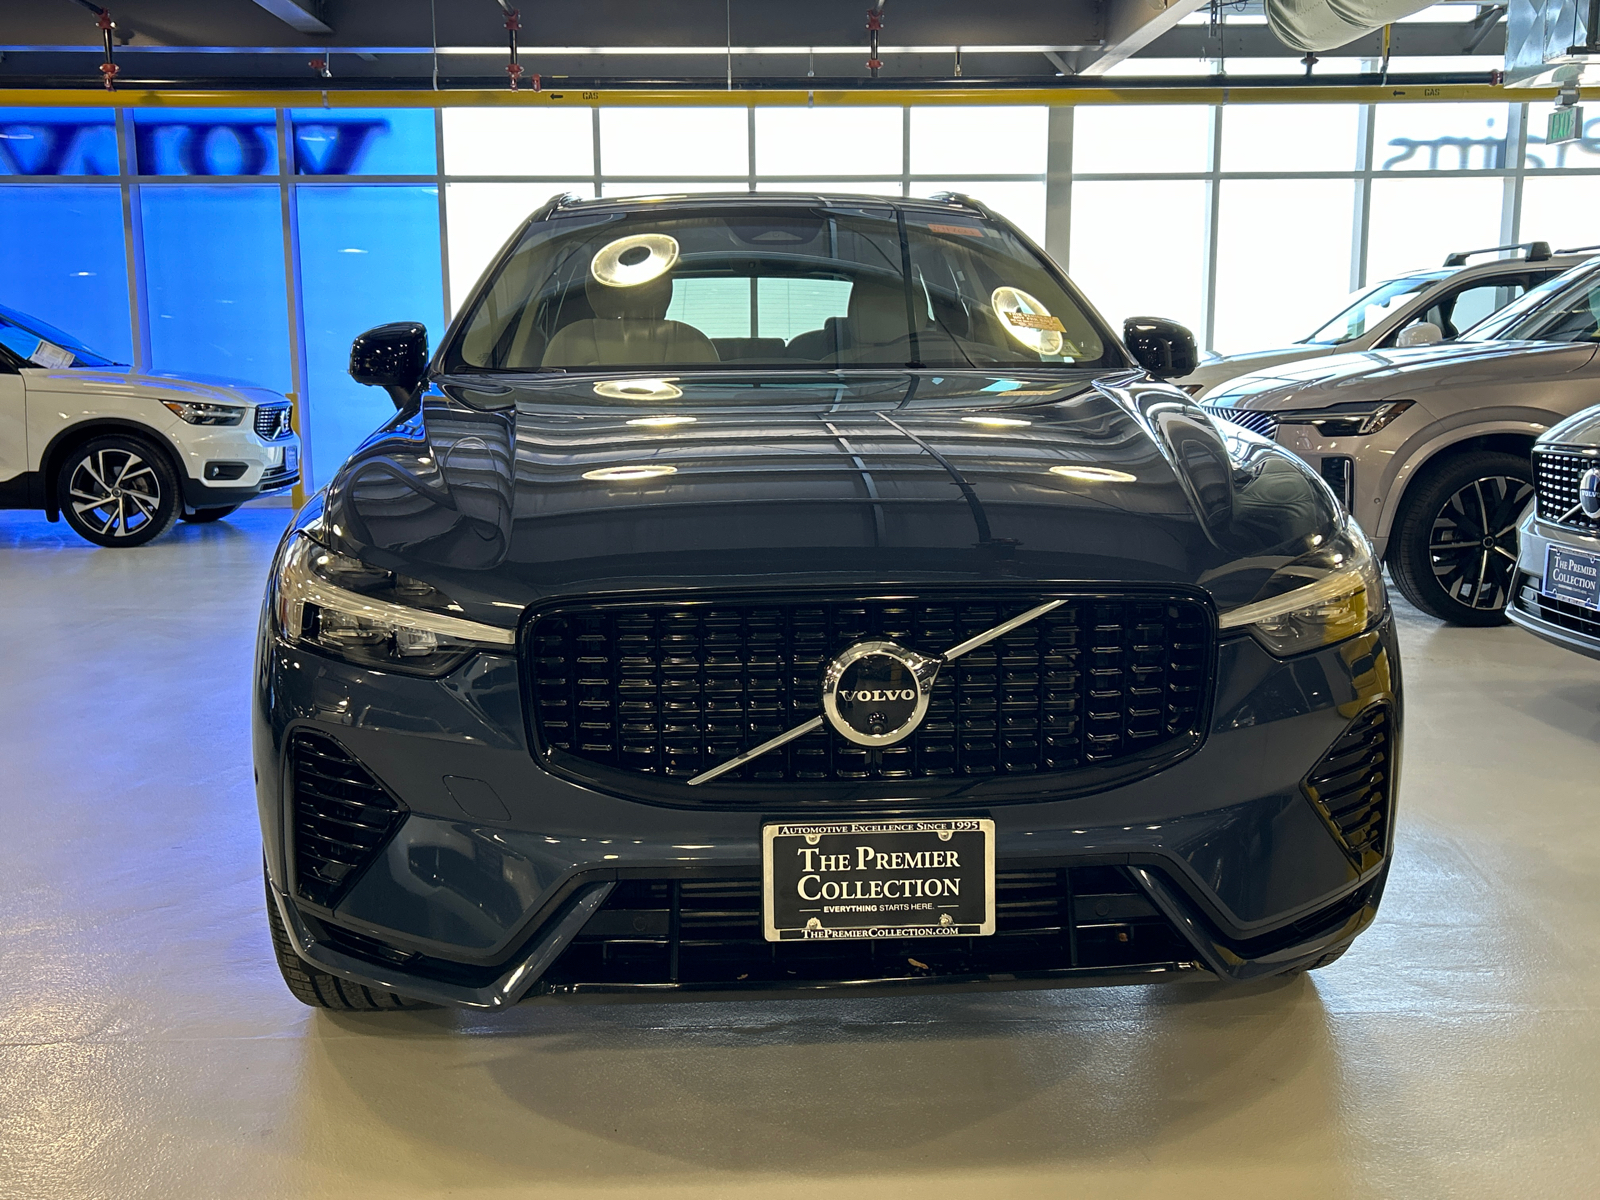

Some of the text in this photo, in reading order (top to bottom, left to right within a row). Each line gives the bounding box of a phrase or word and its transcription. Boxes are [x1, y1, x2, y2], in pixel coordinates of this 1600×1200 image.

[583, 92, 599, 100] GAS
[1424, 88, 1440, 97] GAS
[1551, 109, 1574, 140] EXIT
[1554, 556, 1597, 577] THE PREMIER
[1553, 568, 1596, 590] COLLECTION
[839, 689, 915, 702] VOLVO
[781, 821, 979, 835] AUTOMOTIVE EXCELLENCE SINCE 1995
[797, 846, 961, 872] THE PREMIER
[797, 874, 961, 901] COLLECTION
[824, 902, 935, 913] EVERYTHING STARTS HERE.
